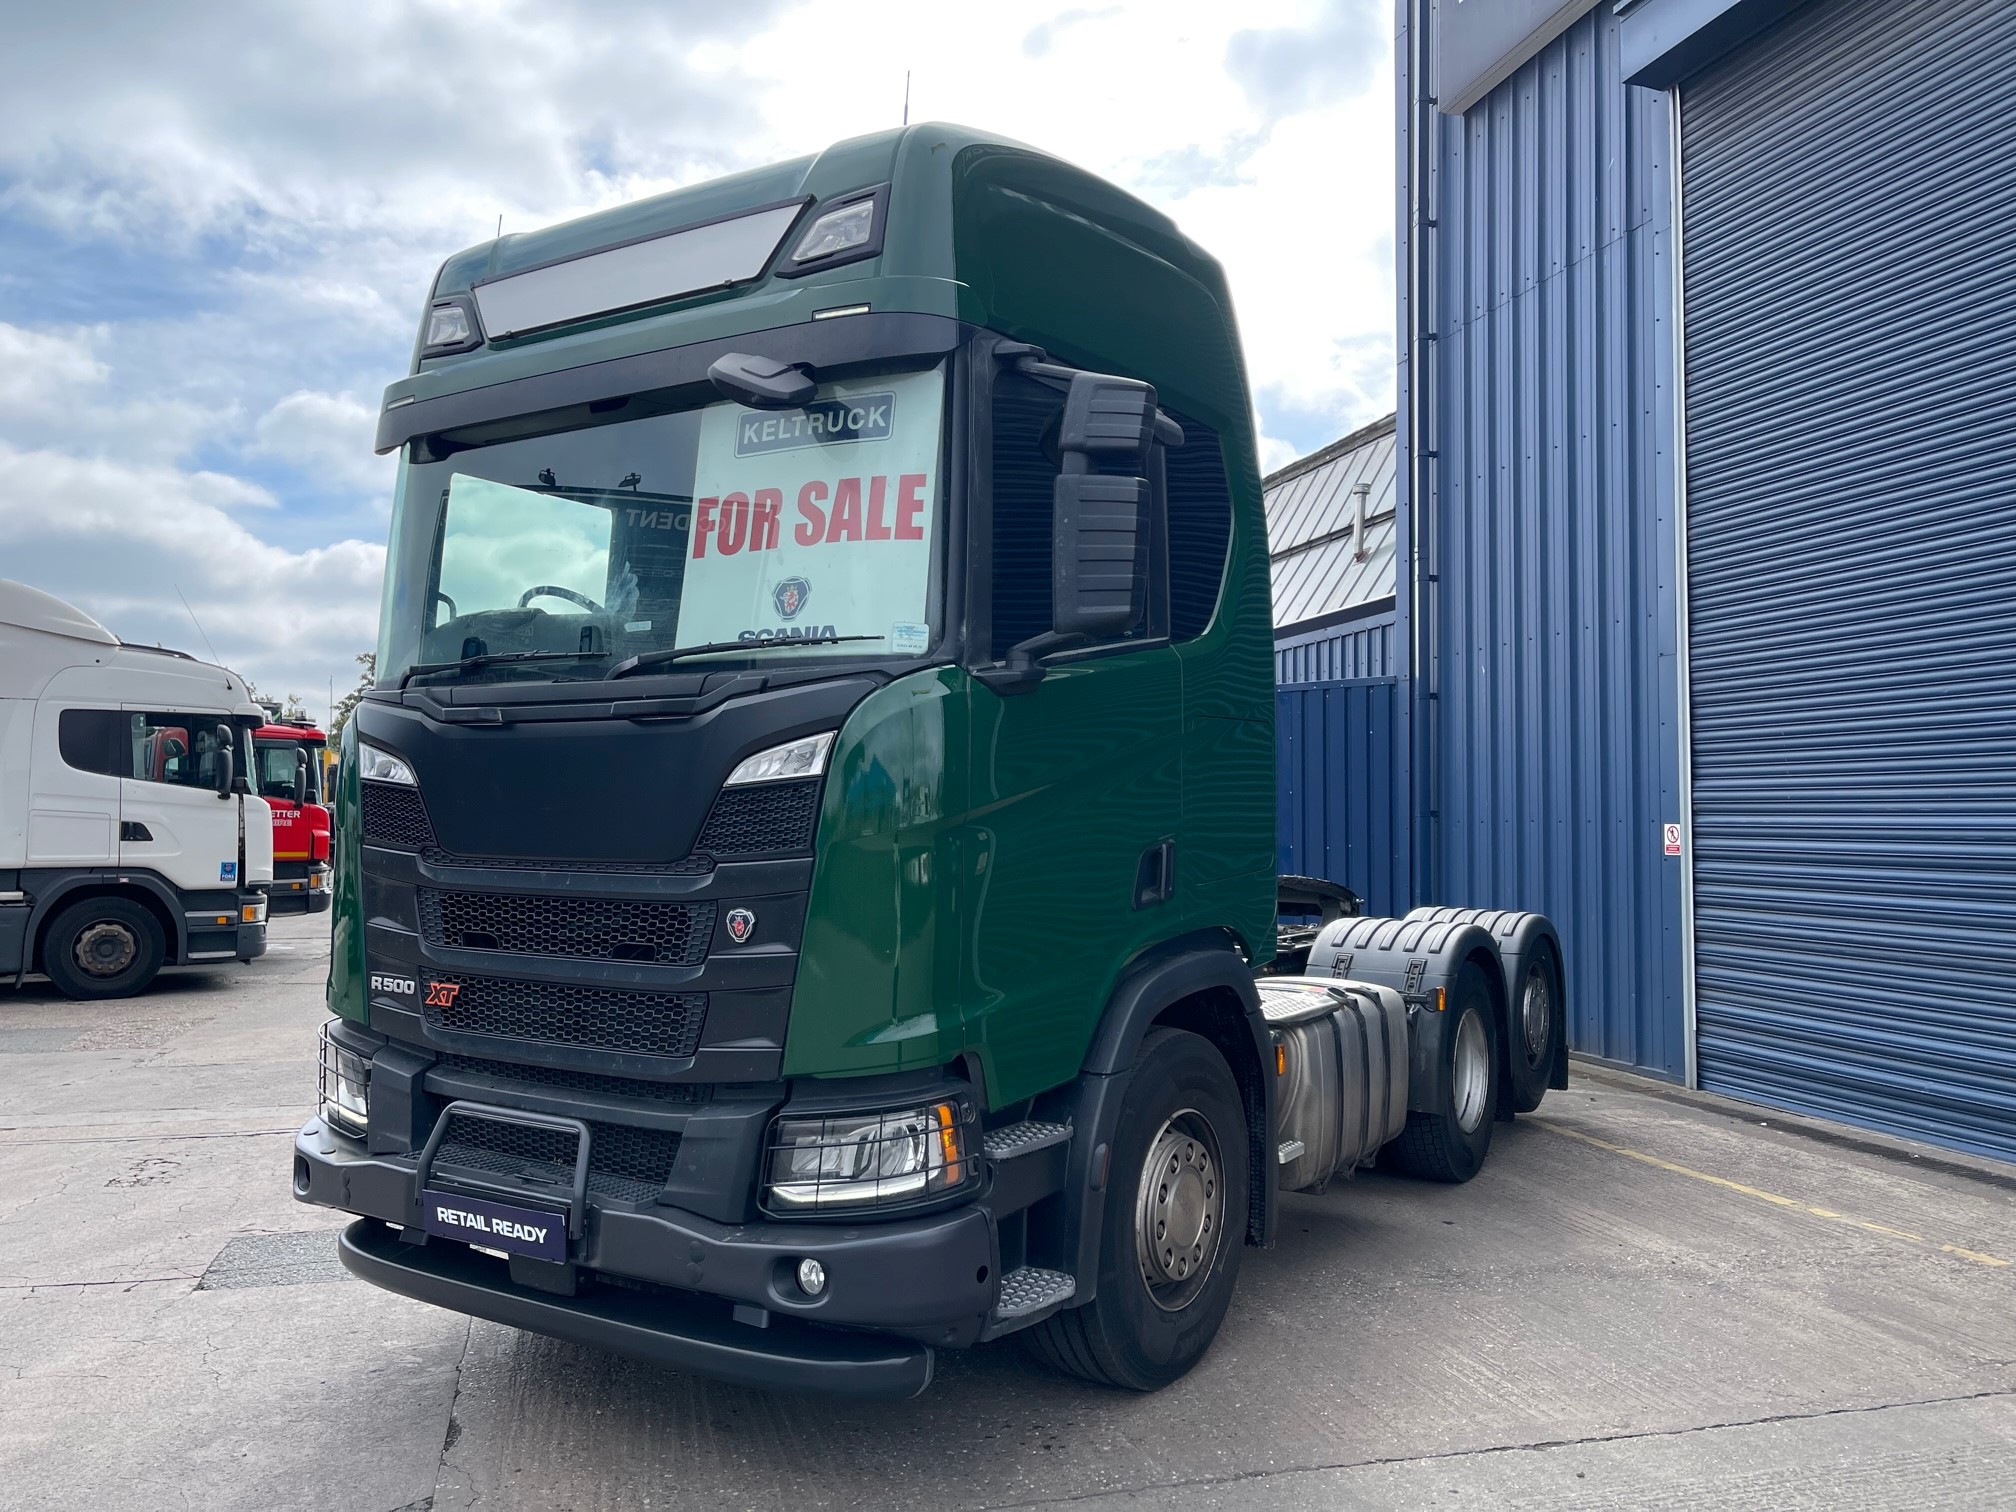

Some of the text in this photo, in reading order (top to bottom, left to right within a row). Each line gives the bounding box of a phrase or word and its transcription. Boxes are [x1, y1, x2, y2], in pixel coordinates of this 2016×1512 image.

[743, 404, 888, 445] KELTRUCK
[692, 473, 927, 559] FOR SALE
[425, 982, 460, 1007] XT
[436, 1206, 547, 1244] RETAIL READY
